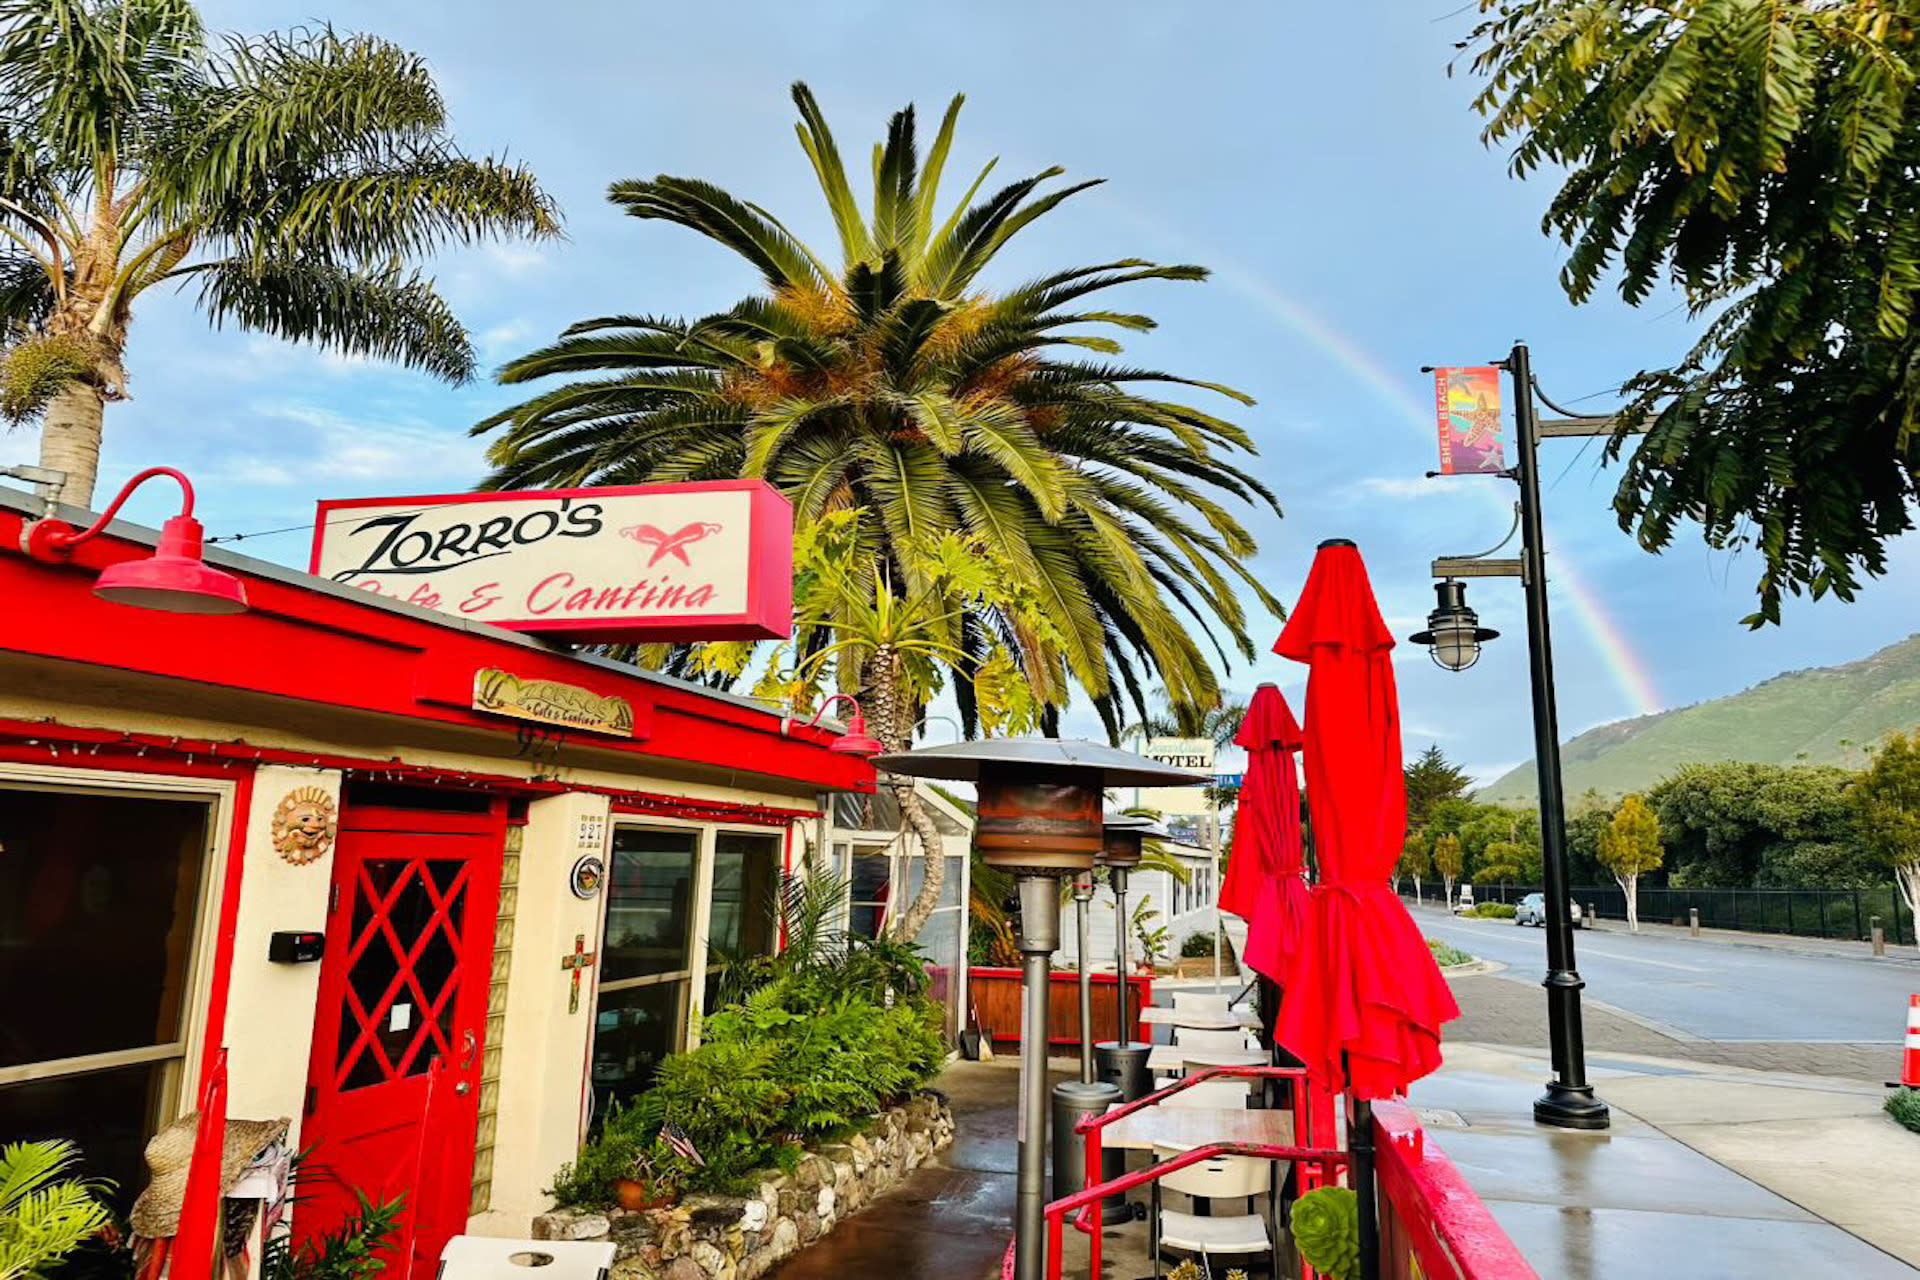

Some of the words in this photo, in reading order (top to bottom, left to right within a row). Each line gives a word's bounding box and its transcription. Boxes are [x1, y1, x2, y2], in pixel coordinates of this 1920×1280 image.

[1437, 377, 1448, 420] BEACH
[1439, 422, 1452, 464] SHELL
[459, 581, 503, 613] &
[526, 571, 718, 615] Cantina
